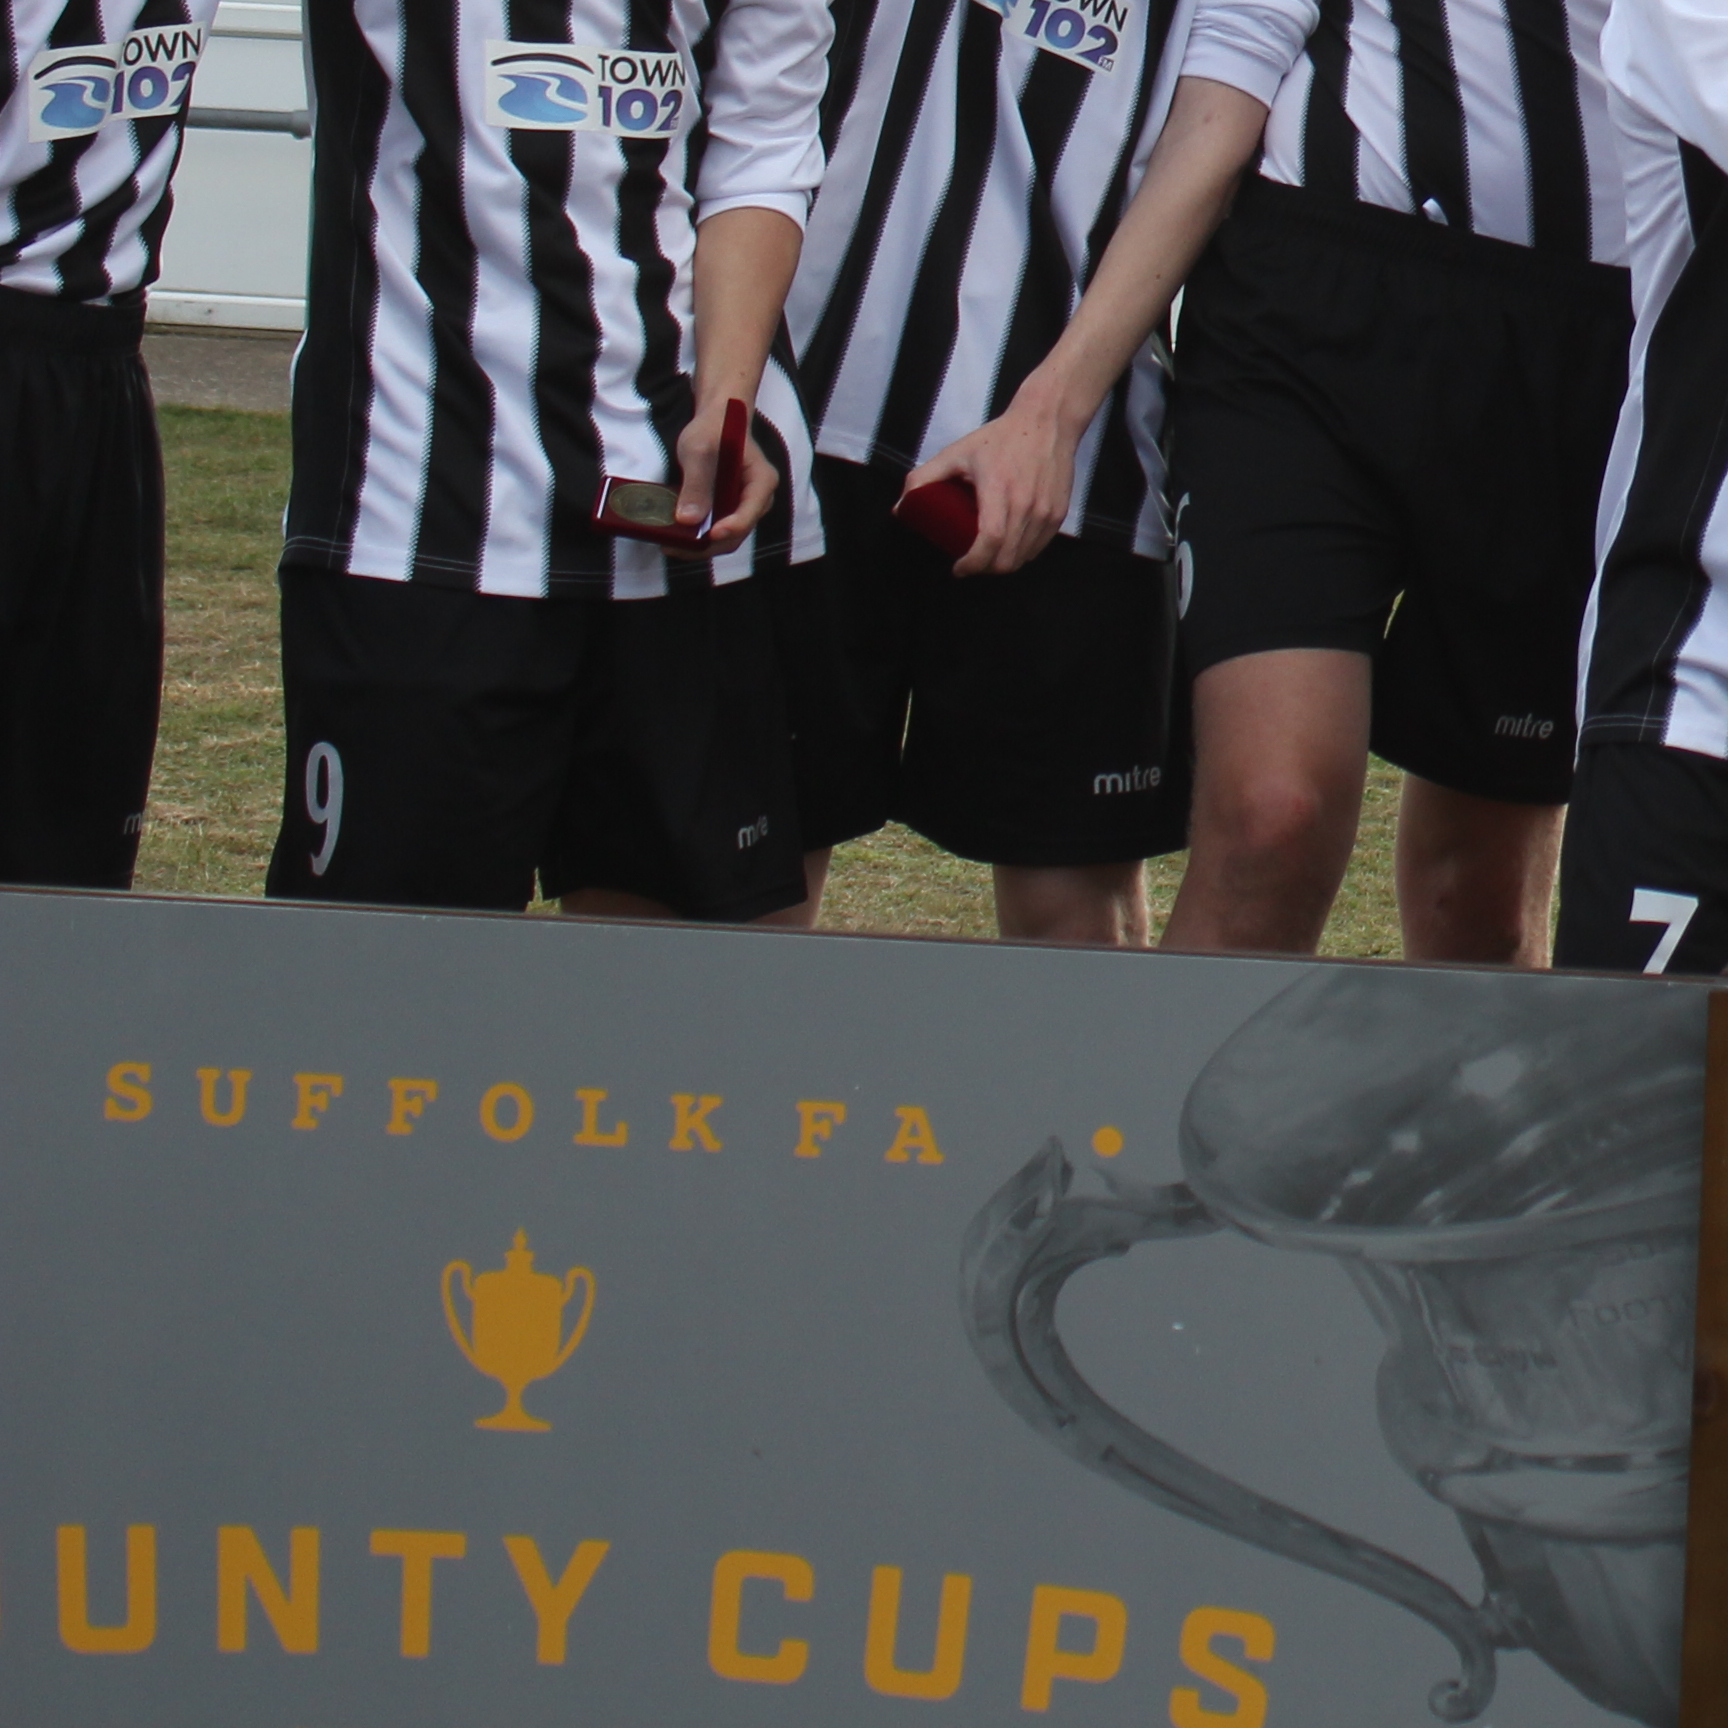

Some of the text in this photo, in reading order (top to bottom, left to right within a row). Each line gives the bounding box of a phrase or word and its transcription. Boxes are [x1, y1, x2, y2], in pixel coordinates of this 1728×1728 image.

[123, 28, 202, 67] OWN
[598, 54, 687, 88] TOWN
[111, 60, 197, 115] 102
[598, 85, 683, 132] 102
[1494, 713, 1555, 741] mitre
[1093, 764, 1163, 796] mitre
[306, 740, 344, 876] 9
[1629, 887, 1700, 975] 7
[104, 1060, 946, 1165] SUFFOLK FA
[707, 1548, 1277, 1728] CUPS
